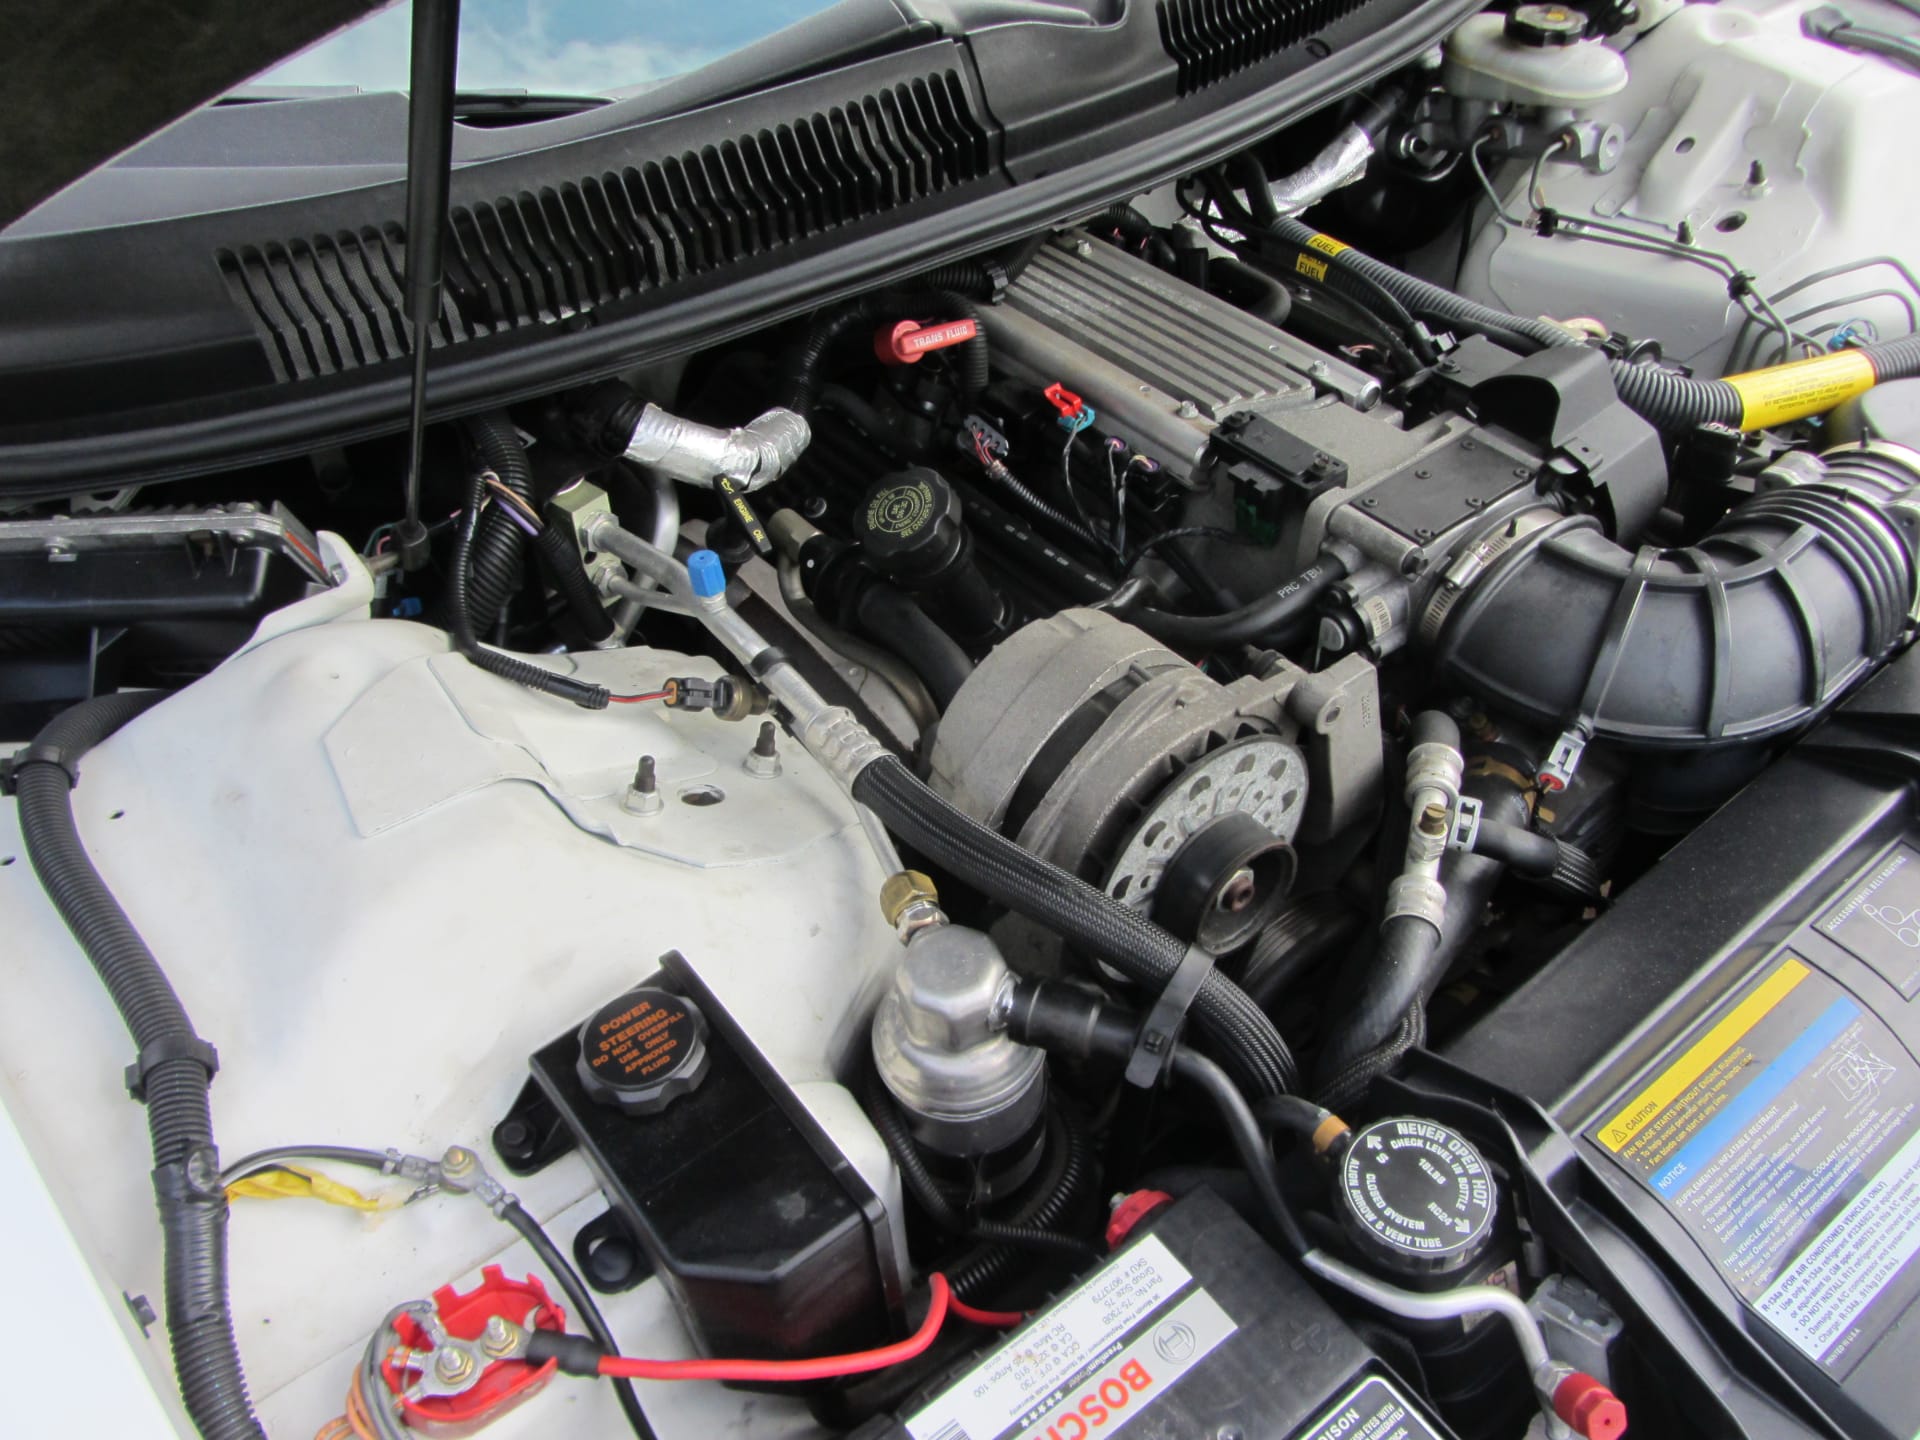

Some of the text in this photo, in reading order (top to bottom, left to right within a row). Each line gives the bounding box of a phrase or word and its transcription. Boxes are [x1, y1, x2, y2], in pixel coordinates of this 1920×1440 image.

[1312, 238, 1336, 254] FUEL
[1299, 262, 1322, 280] FUEL
[914, 325, 968, 348] TRANS FLUID
[733, 498, 764, 543] ENGINE OIL
[598, 1008, 668, 1052] STEERING
[600, 1002, 652, 1034] POWER
[592, 1012, 685, 1068] DO NOT OVERFILL
[618, 1031, 670, 1064] USE ONLY
[624, 1040, 678, 1073] APPROVED
[640, 1055, 671, 1075] FLUID
[1622, 1144, 1638, 1159] FAN
[1633, 1126, 1657, 1149] BLADE
[1652, 1107, 1677, 1132] STARTS
[1673, 1085, 1701, 1112] WITHOUT
[1624, 1099, 1658, 1131] CAUTION
[1396, 1123, 1487, 1208] NEVER OPEN HOT
[1648, 1152, 1662, 1166] Fan
[1674, 1105, 1779, 1207] SUPPLEMENTAL INFLATABLE RESTRAINT
[1347, 1158, 1360, 1187] ALIGN
[1390, 1138, 1469, 1211] CHECK LEVEL IN BOTTLE
[1657, 1161, 1687, 1190] NOTICE
[1350, 1188, 1377, 1222] ARROW
[1366, 1173, 1425, 1231] CLOSED SYSTEM
[1427, 1202, 1453, 1226] RC24
[1722, 1251, 1738, 1266] THIS
[1735, 1227, 1761, 1254] VEHICLE
[1757, 1199, 1789, 1231] REQUIRES
[1784, 1195, 1793, 1204] A
[1789, 1174, 1814, 1199] SPECIAL
[1810, 1150, 1838, 1177] COOLANT
[1384, 1227, 1412, 1245] VENT
[1414, 1237, 1442, 1248] TUBE
[1128, 1256, 1148, 1274] SKU
[1760, 1288, 1783, 1312] R-134a
[1779, 1273, 1797, 1292] (FOR
[1794, 1262, 1808, 1277] AIR
[1804, 1223, 1846, 1266] CONDITIONED
[1841, 1196, 1871, 1227] VEHICLES
[1103, 1264, 1155, 1309] Group Size 75
[1144, 1273, 1163, 1290] Part
[1778, 1295, 1793, 1310] Use
[1789, 1282, 1806, 1299] only
[1801, 1264, 1823, 1286] R-134a
[1821, 1273, 1832, 1283] to
[1828, 1262, 1841, 1276] GM
[1797, 1313, 1810, 1326] DO
[1806, 1300, 1823, 1317] NOT
[1819, 1276, 1845, 1303] INSTALL
[1841, 1265, 1856, 1280] R12
[1807, 1307, 1834, 1335] Damage
[1829, 1301, 1839, 1311] to
[1836, 1290, 1850, 1304] A/C
[1050, 1322, 1066, 1337] RC
[1057, 1331, 1073, 1346] CA
[1060, 1340, 1081, 1359] CCA
[1362, 1416, 1381, 1436] EYES
